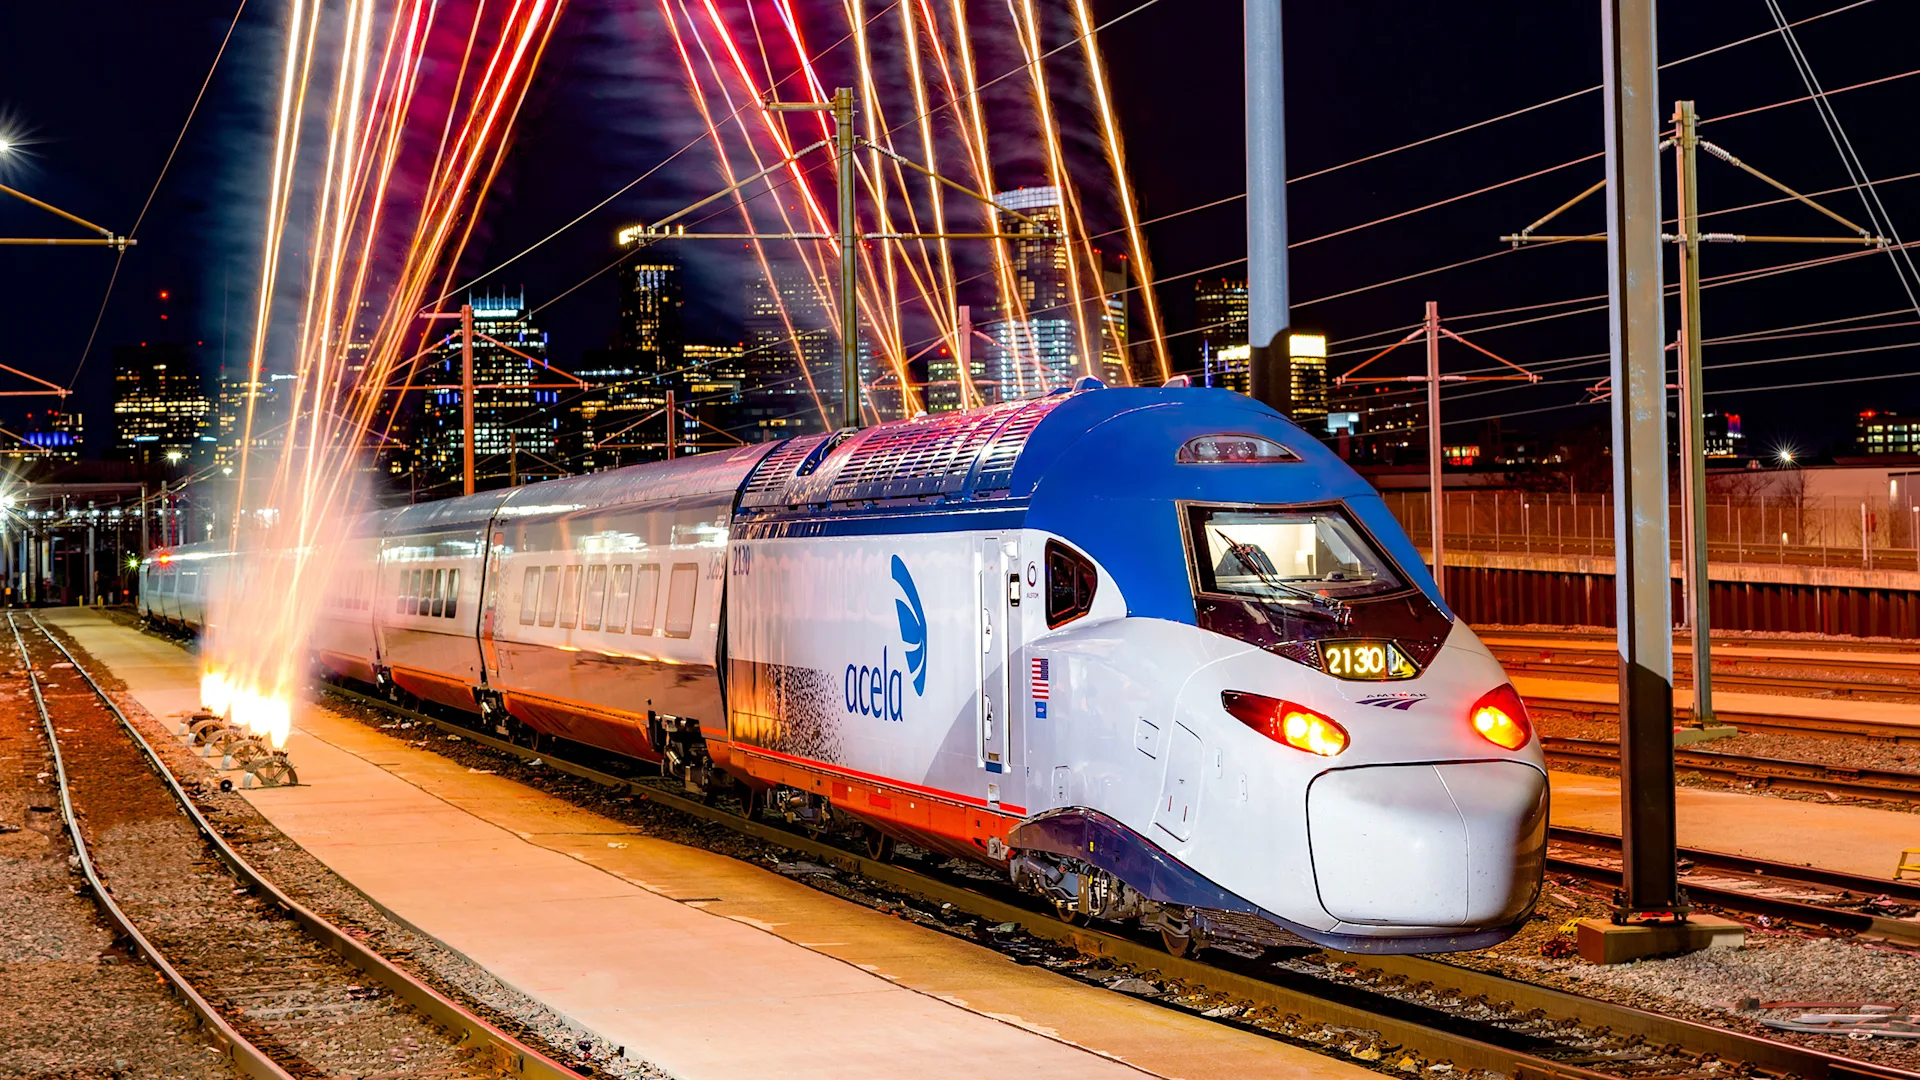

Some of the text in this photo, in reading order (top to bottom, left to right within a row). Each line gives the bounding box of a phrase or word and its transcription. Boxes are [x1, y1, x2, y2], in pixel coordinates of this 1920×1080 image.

[732, 544, 751, 576] 2130
[1326, 647, 1383, 673] 2130
[845, 645, 903, 722] acela
